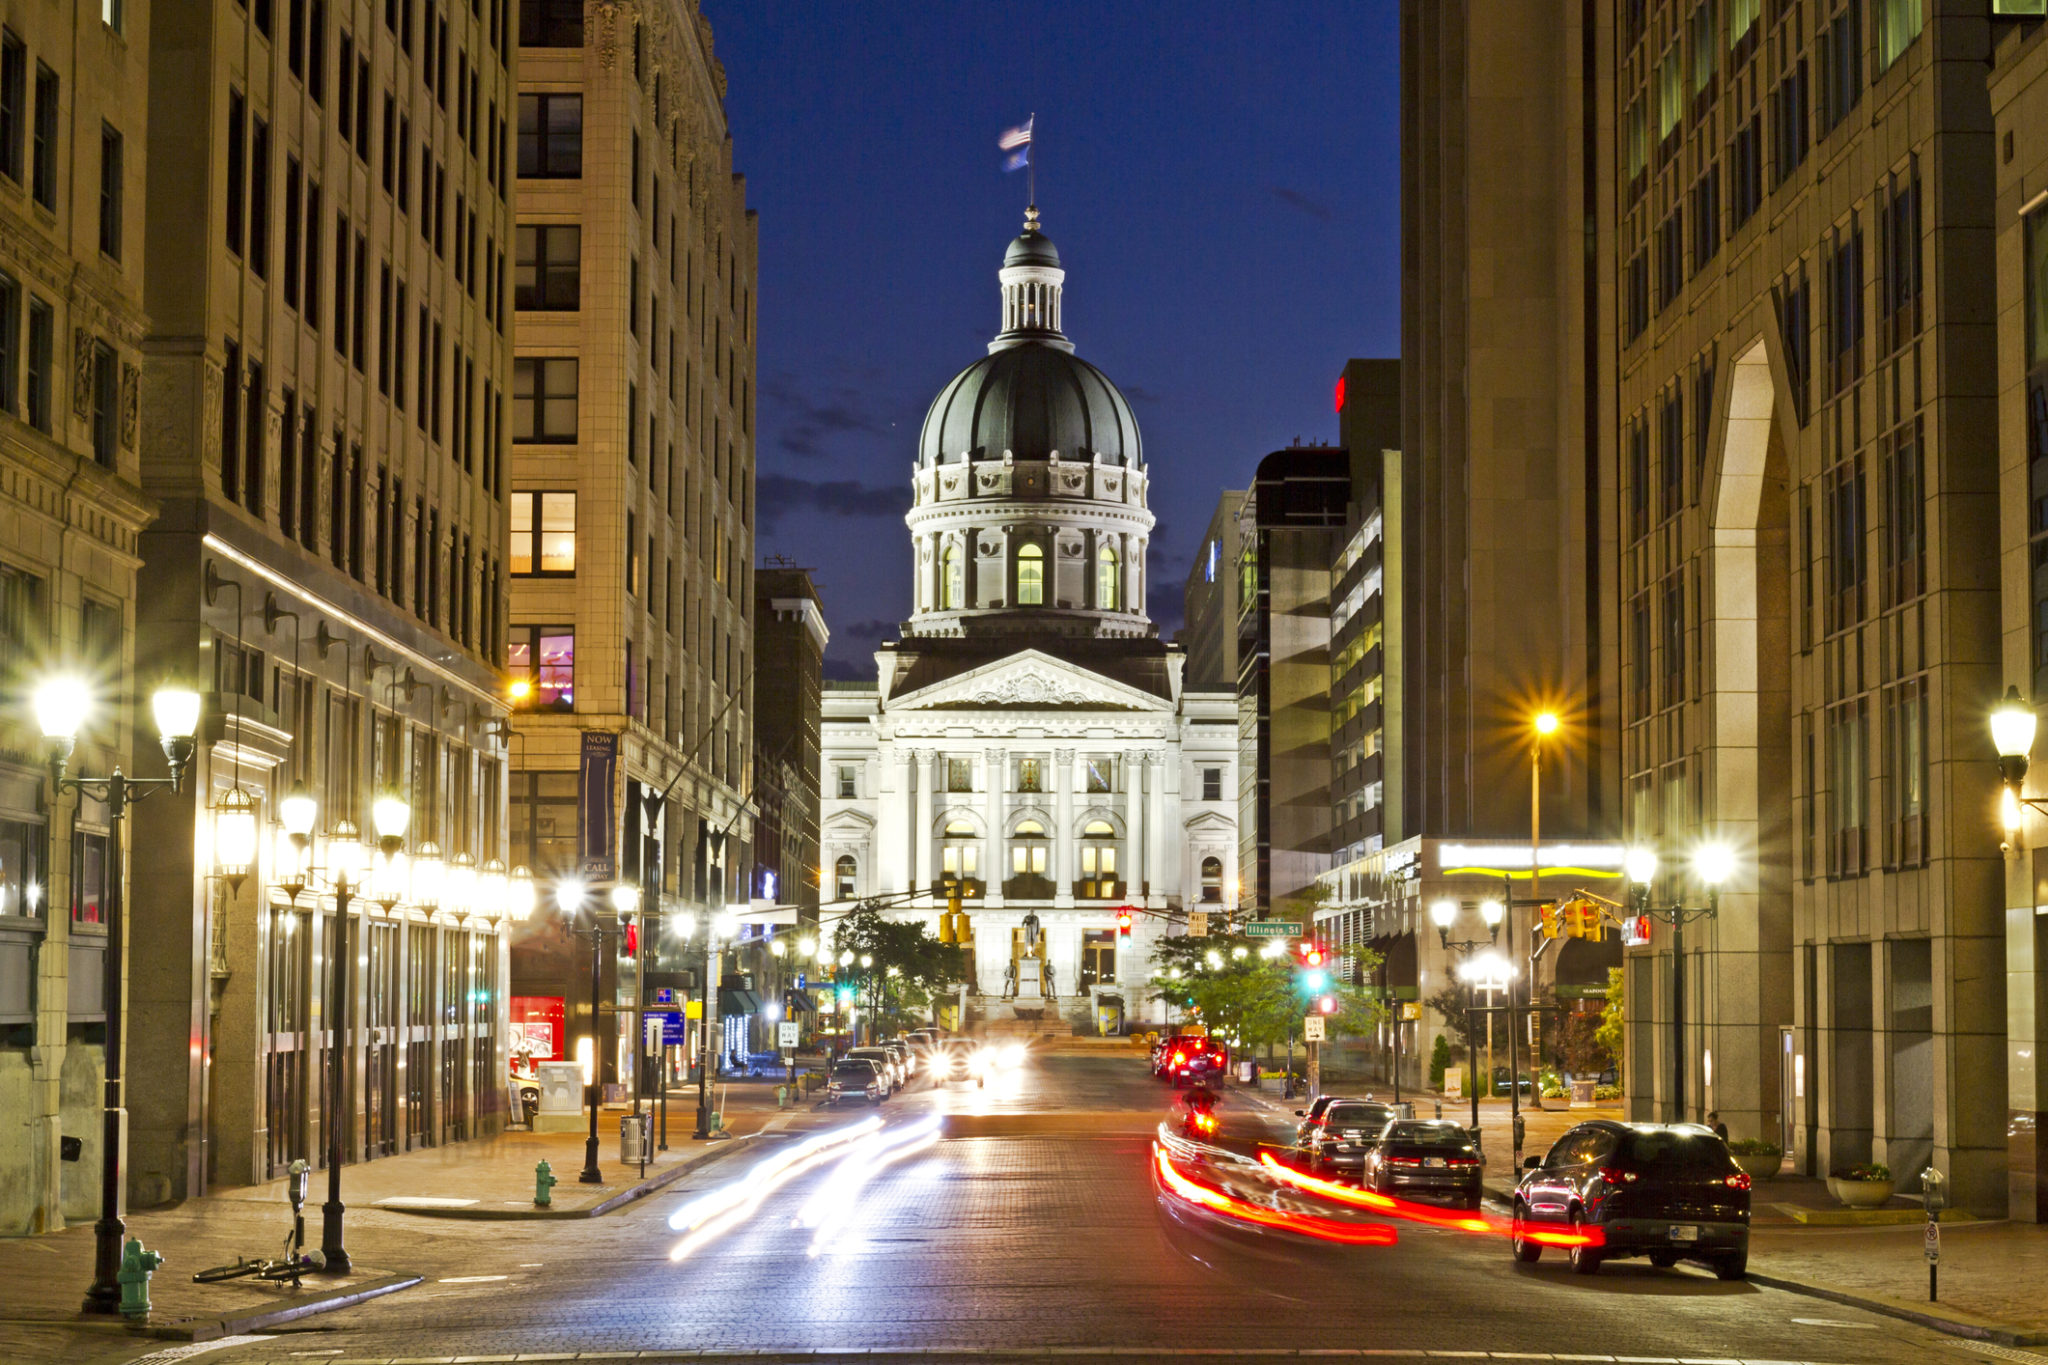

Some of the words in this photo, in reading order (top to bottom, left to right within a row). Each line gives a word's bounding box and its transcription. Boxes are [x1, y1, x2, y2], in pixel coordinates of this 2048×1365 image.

[587, 735, 612, 743] NOW
[584, 863, 609, 872] CALL
[1248, 925, 1284, 934] Illinois
[1288, 925, 1299, 934] St
